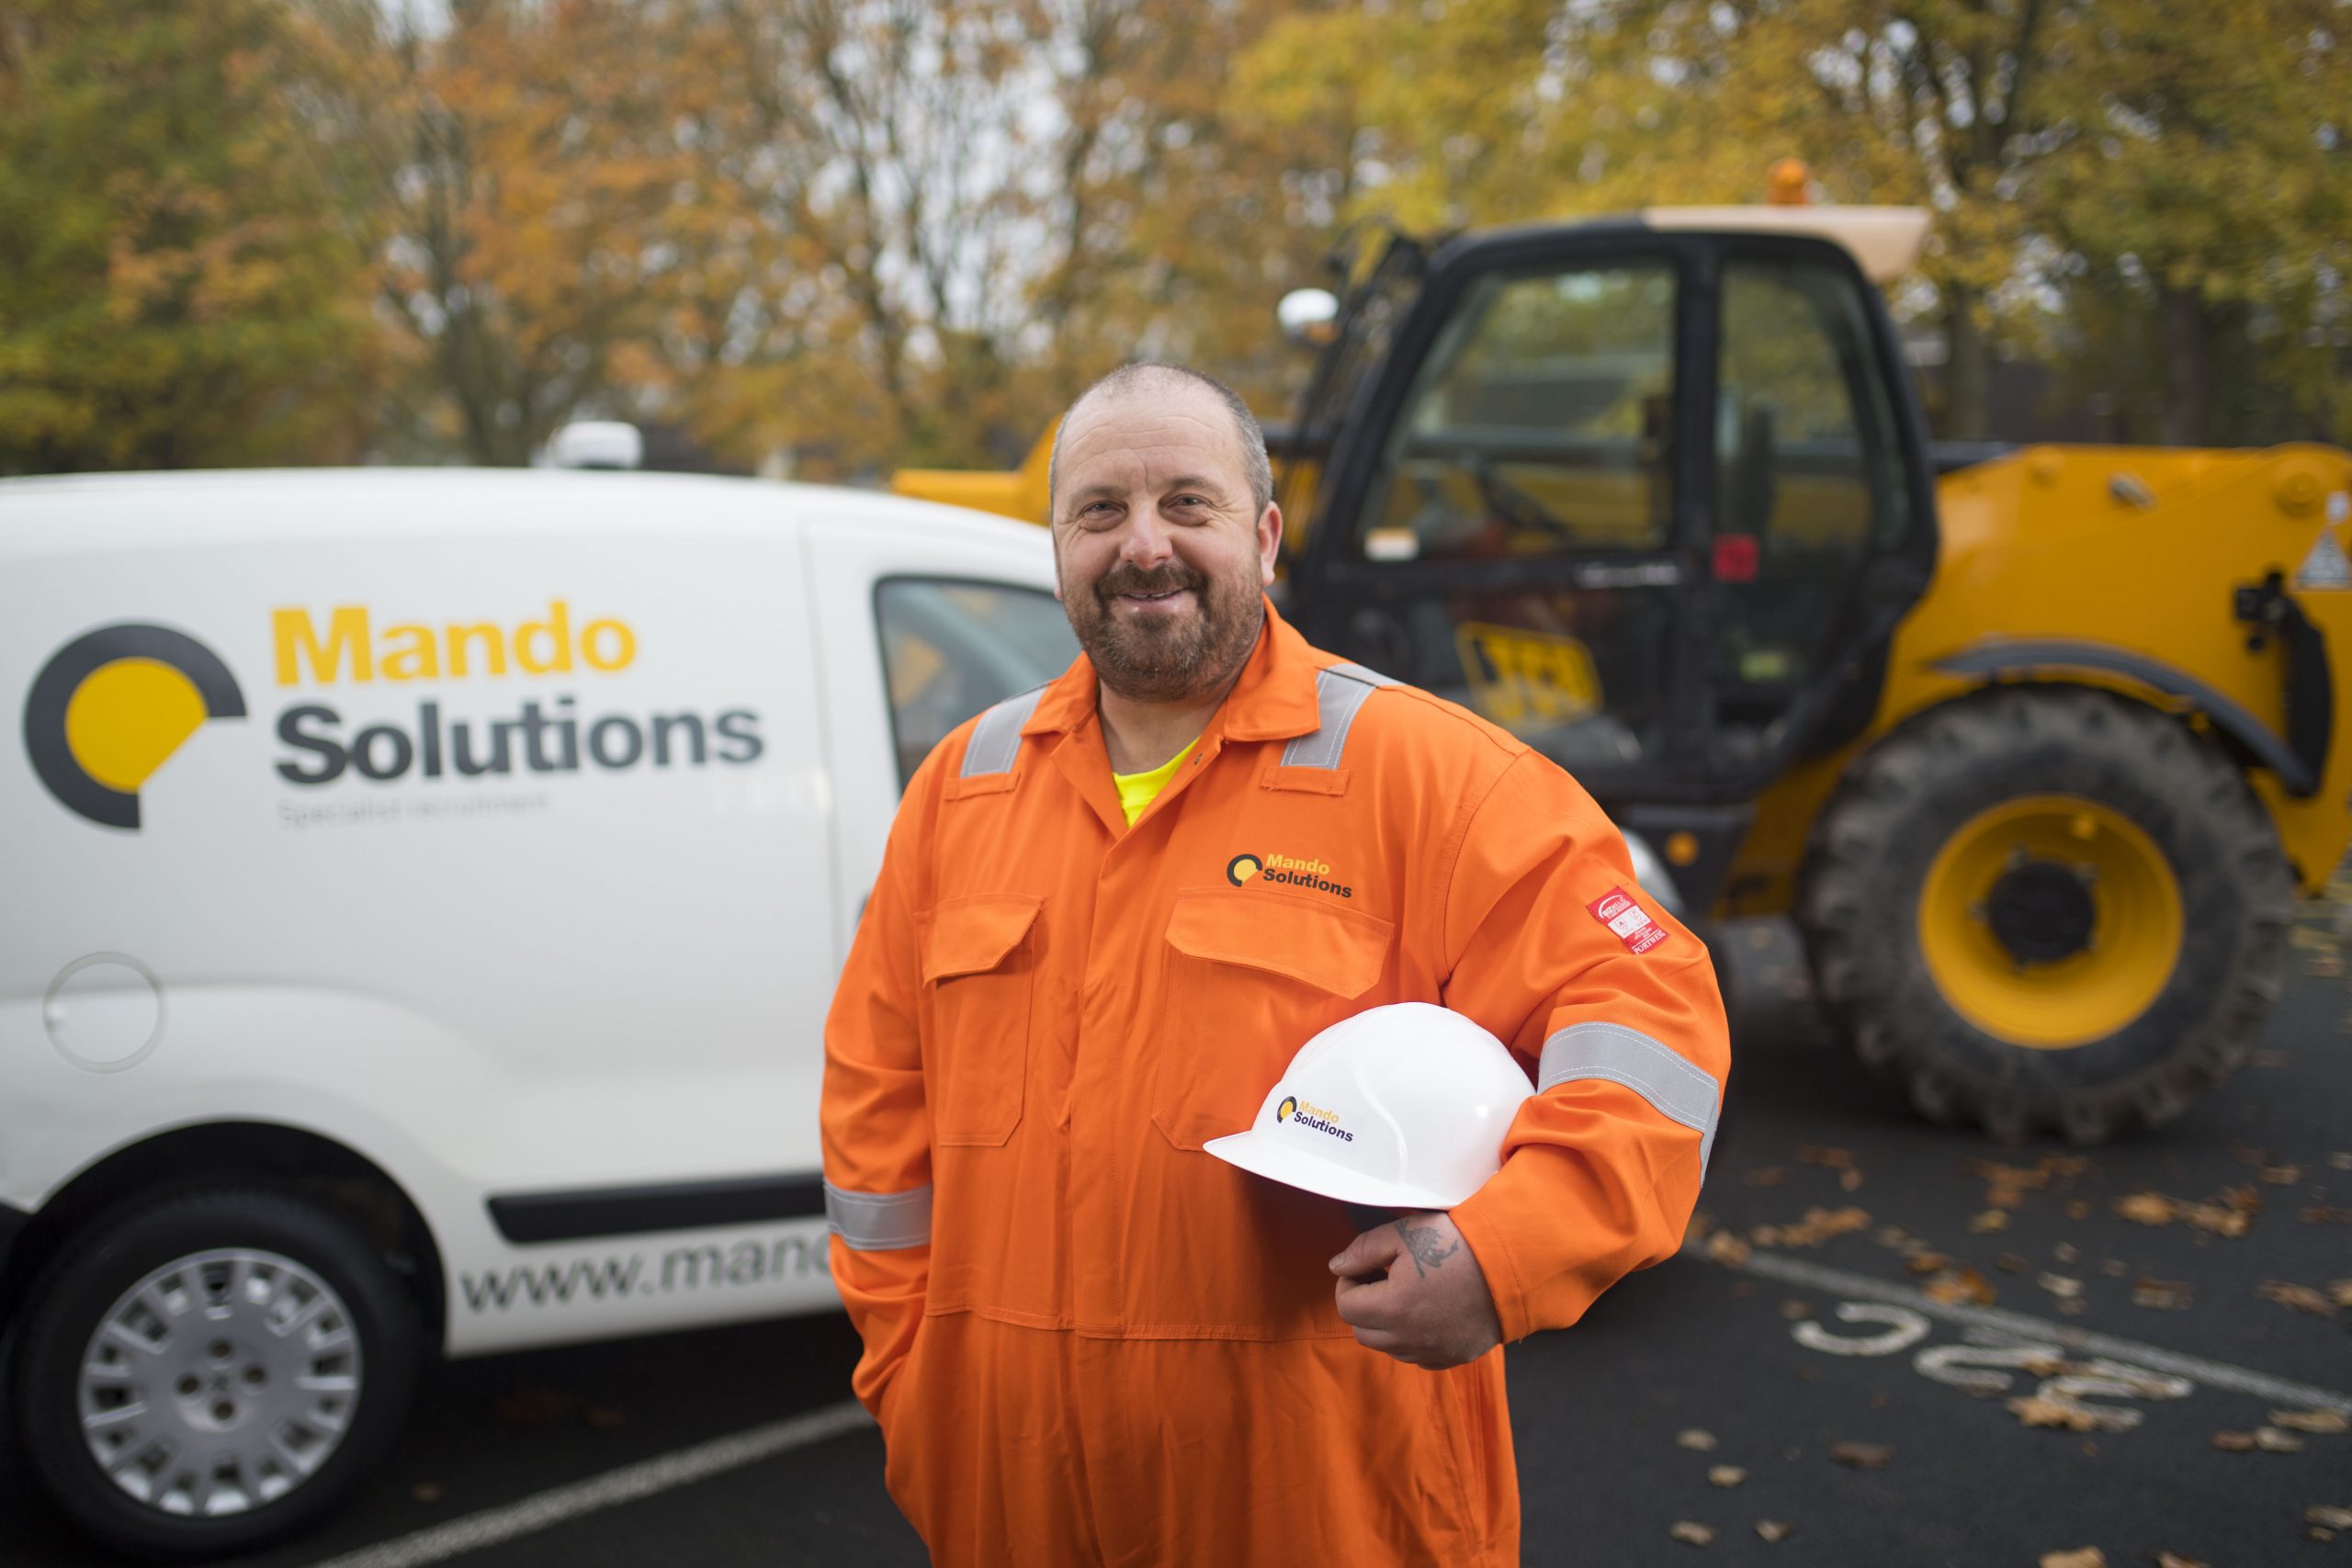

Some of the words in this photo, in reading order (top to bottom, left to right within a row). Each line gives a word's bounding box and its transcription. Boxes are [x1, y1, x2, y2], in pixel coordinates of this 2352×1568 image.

[271, 600, 638, 688] Mando
[275, 695, 765, 788] Solutions
[1266, 853, 1330, 875] Mando
[1263, 868, 1352, 898] Solutions
[1295, 1111, 1354, 1143] Solutions
[1298, 1100, 1340, 1123] Mando
[461, 1232, 831, 1314] www.man
